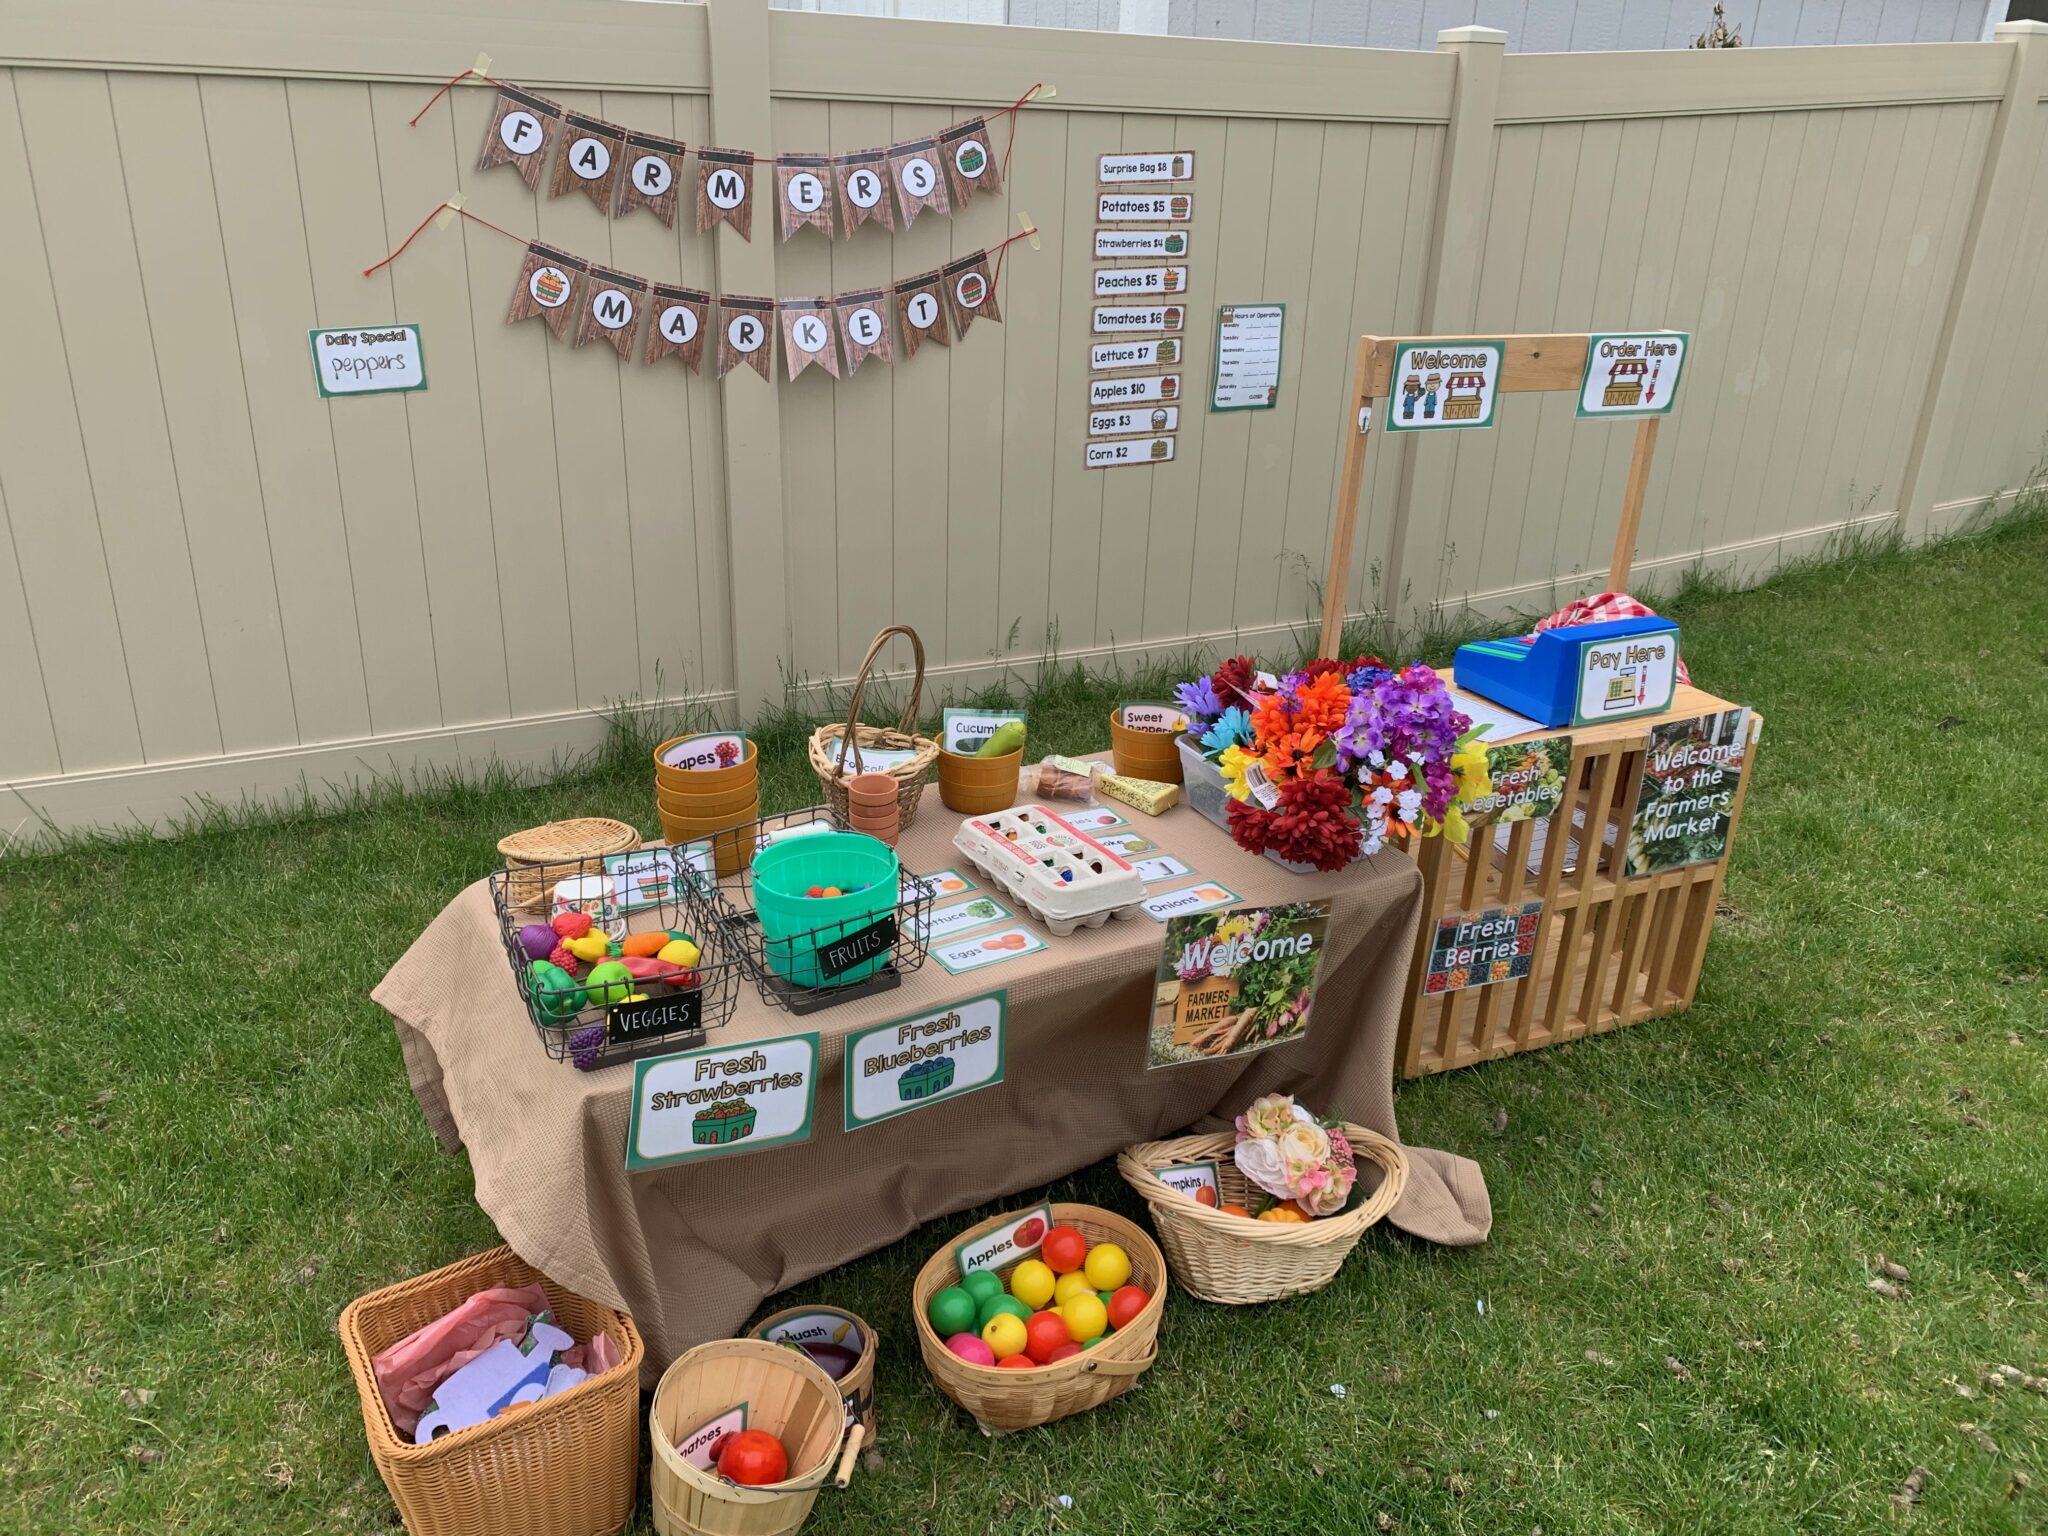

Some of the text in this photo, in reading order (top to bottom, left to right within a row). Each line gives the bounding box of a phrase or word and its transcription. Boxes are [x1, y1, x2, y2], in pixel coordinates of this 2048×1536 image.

[1103, 161, 1168, 175] Surprise Bag $8
[1101, 200, 1166, 213] Potatoes $5
[1097, 237, 1164, 249] Strawberries $4
[1097, 274, 1158, 288] Peaches $5
[1097, 312, 1162, 325] Tomatoes $6
[325, 329, 407, 346] Daily Special
[1094, 347, 1149, 363] Lettuce $7
[1411, 350, 1488, 370] Welcome
[1600, 340, 1678, 360] Order Here
[1093, 383, 1146, 400] Apples $10
[1092, 415, 1131, 430] Eggs $3
[1089, 447, 1128, 461] Corn $2
[1589, 643, 1666, 671] Pay Here
[1127, 712, 1163, 723] Sweet
[956, 722, 1001, 735] Cucumb
[668, 753, 716, 770] apes
[1654, 740, 1742, 773] Welcome
[1491, 766, 1539, 786] Fresh
[1664, 768, 1723, 796] to the
[1643, 791, 1730, 821] Farmers
[1644, 813, 1721, 844] Market
[1149, 895, 1200, 913] Onions
[1458, 916, 1516, 942] Fresh
[828, 930, 882, 970] FRUITS
[948, 946, 983, 961] Eggs
[1183, 932, 1313, 971] Welcome
[1444, 940, 1520, 968] Berries
[1187, 989, 1230, 1008] FARMERS
[619, 1003, 691, 1033] VEGGIES
[1185, 1005, 1229, 1023] MARKET
[898, 1011, 961, 1046] Fresh
[863, 1025, 992, 1078] Blueberries
[694, 1051, 767, 1082] Fresh
[651, 1070, 803, 1112] Strawberries
[967, 1239, 1013, 1269] Apples
